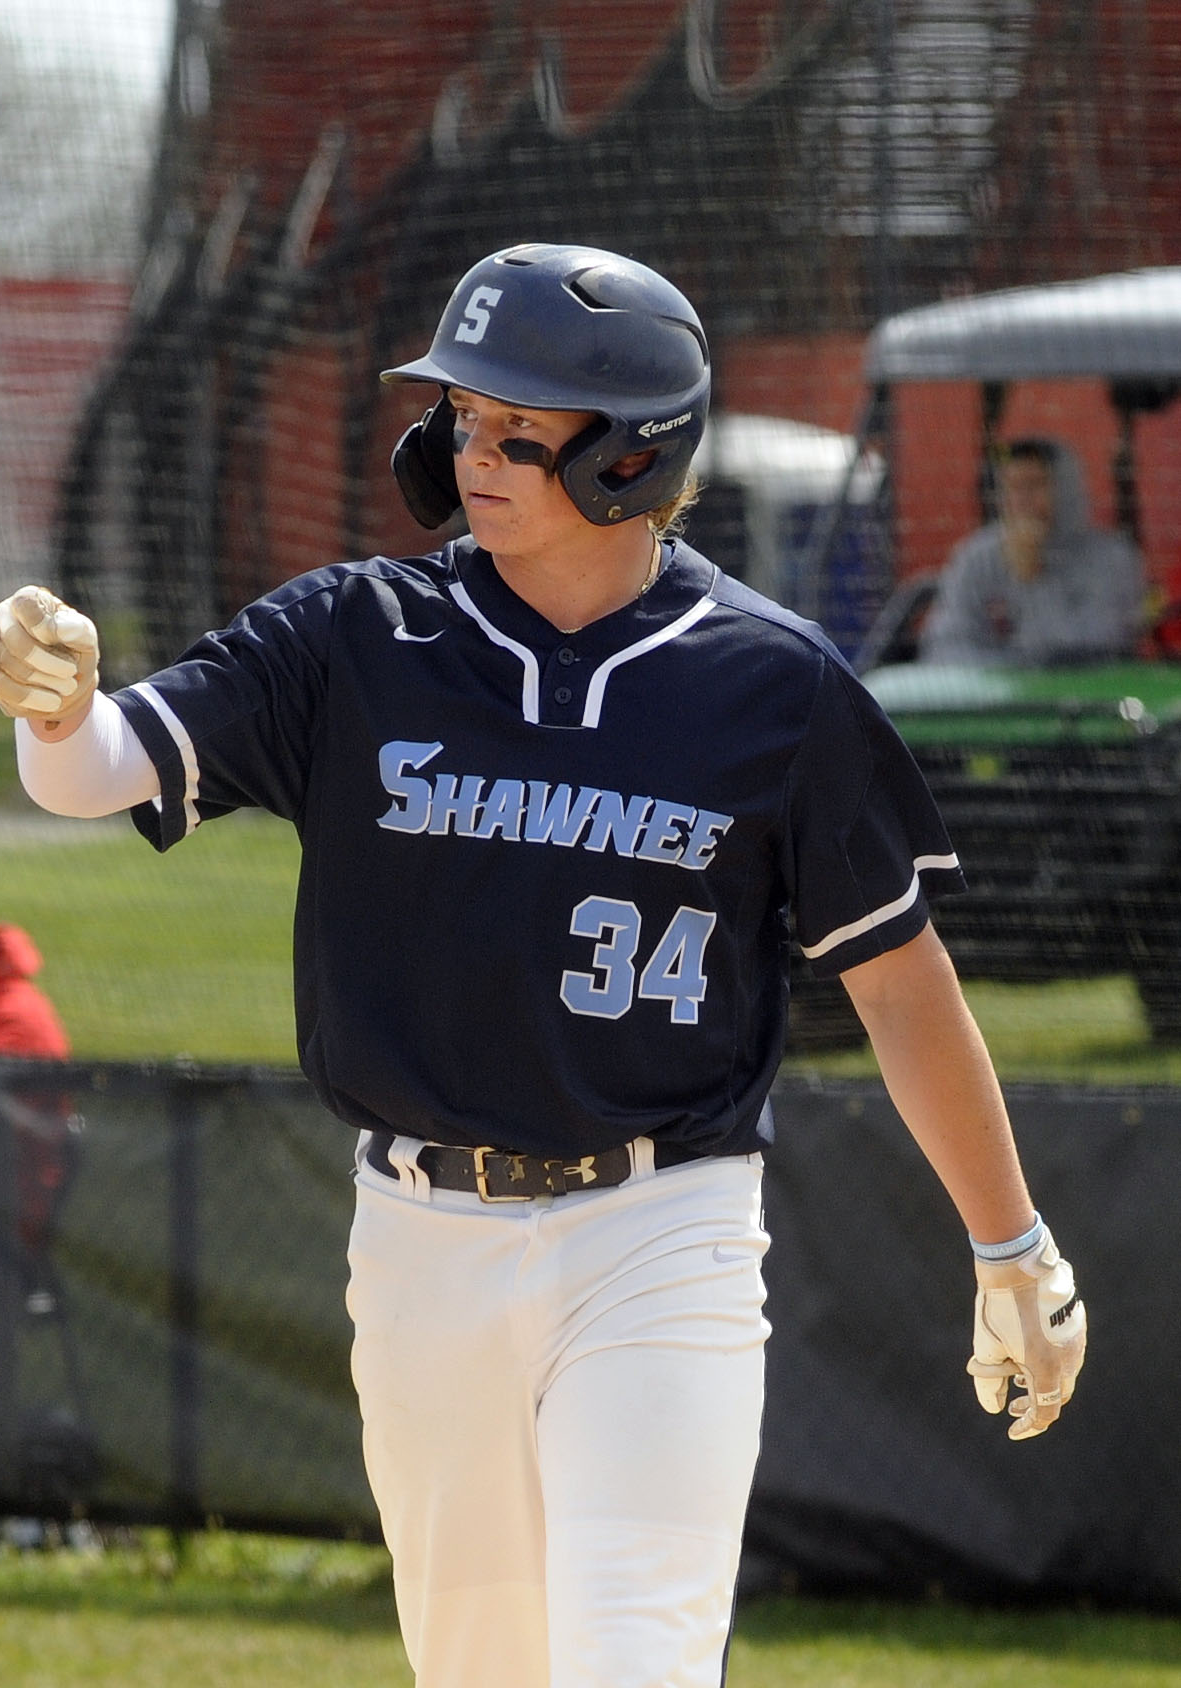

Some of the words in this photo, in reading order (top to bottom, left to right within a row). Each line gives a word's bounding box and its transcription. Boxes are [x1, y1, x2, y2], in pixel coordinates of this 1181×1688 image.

[455, 286, 503, 344] S
[649, 411, 692, 434] EASTON
[376, 740, 734, 870] SHAWNEE
[559, 894, 717, 1025] 34
